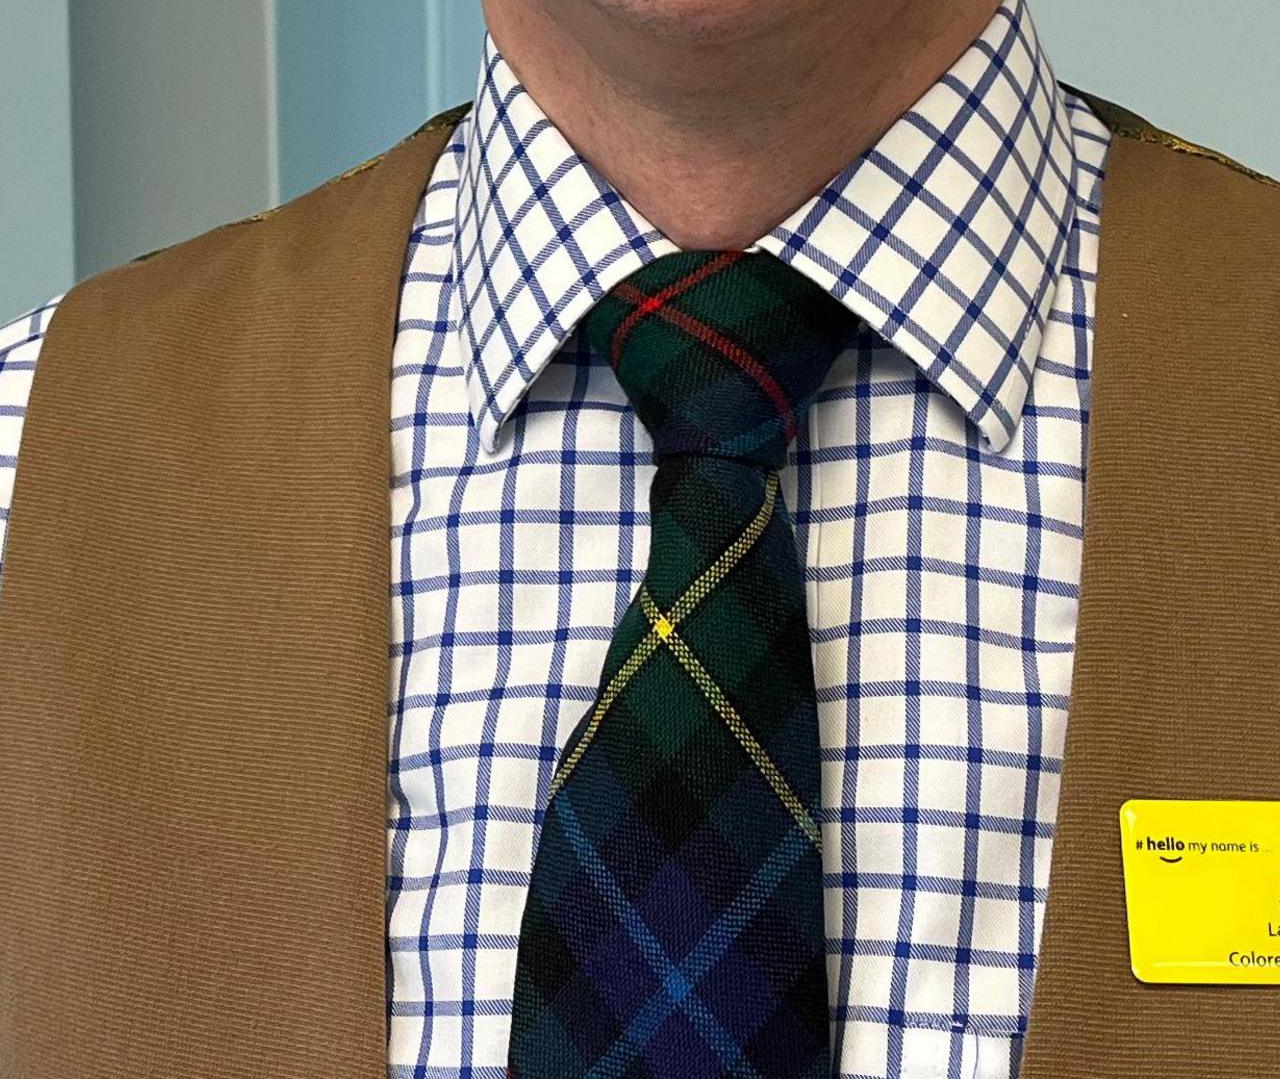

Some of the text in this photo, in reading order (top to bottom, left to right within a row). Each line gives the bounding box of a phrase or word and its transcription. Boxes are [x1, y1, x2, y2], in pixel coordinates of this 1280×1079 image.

[1135, 839, 1143, 850] #
[1146, 836, 1185, 851] hello
[1188, 841, 1207, 854] my
[1211, 842, 1246, 852] name
